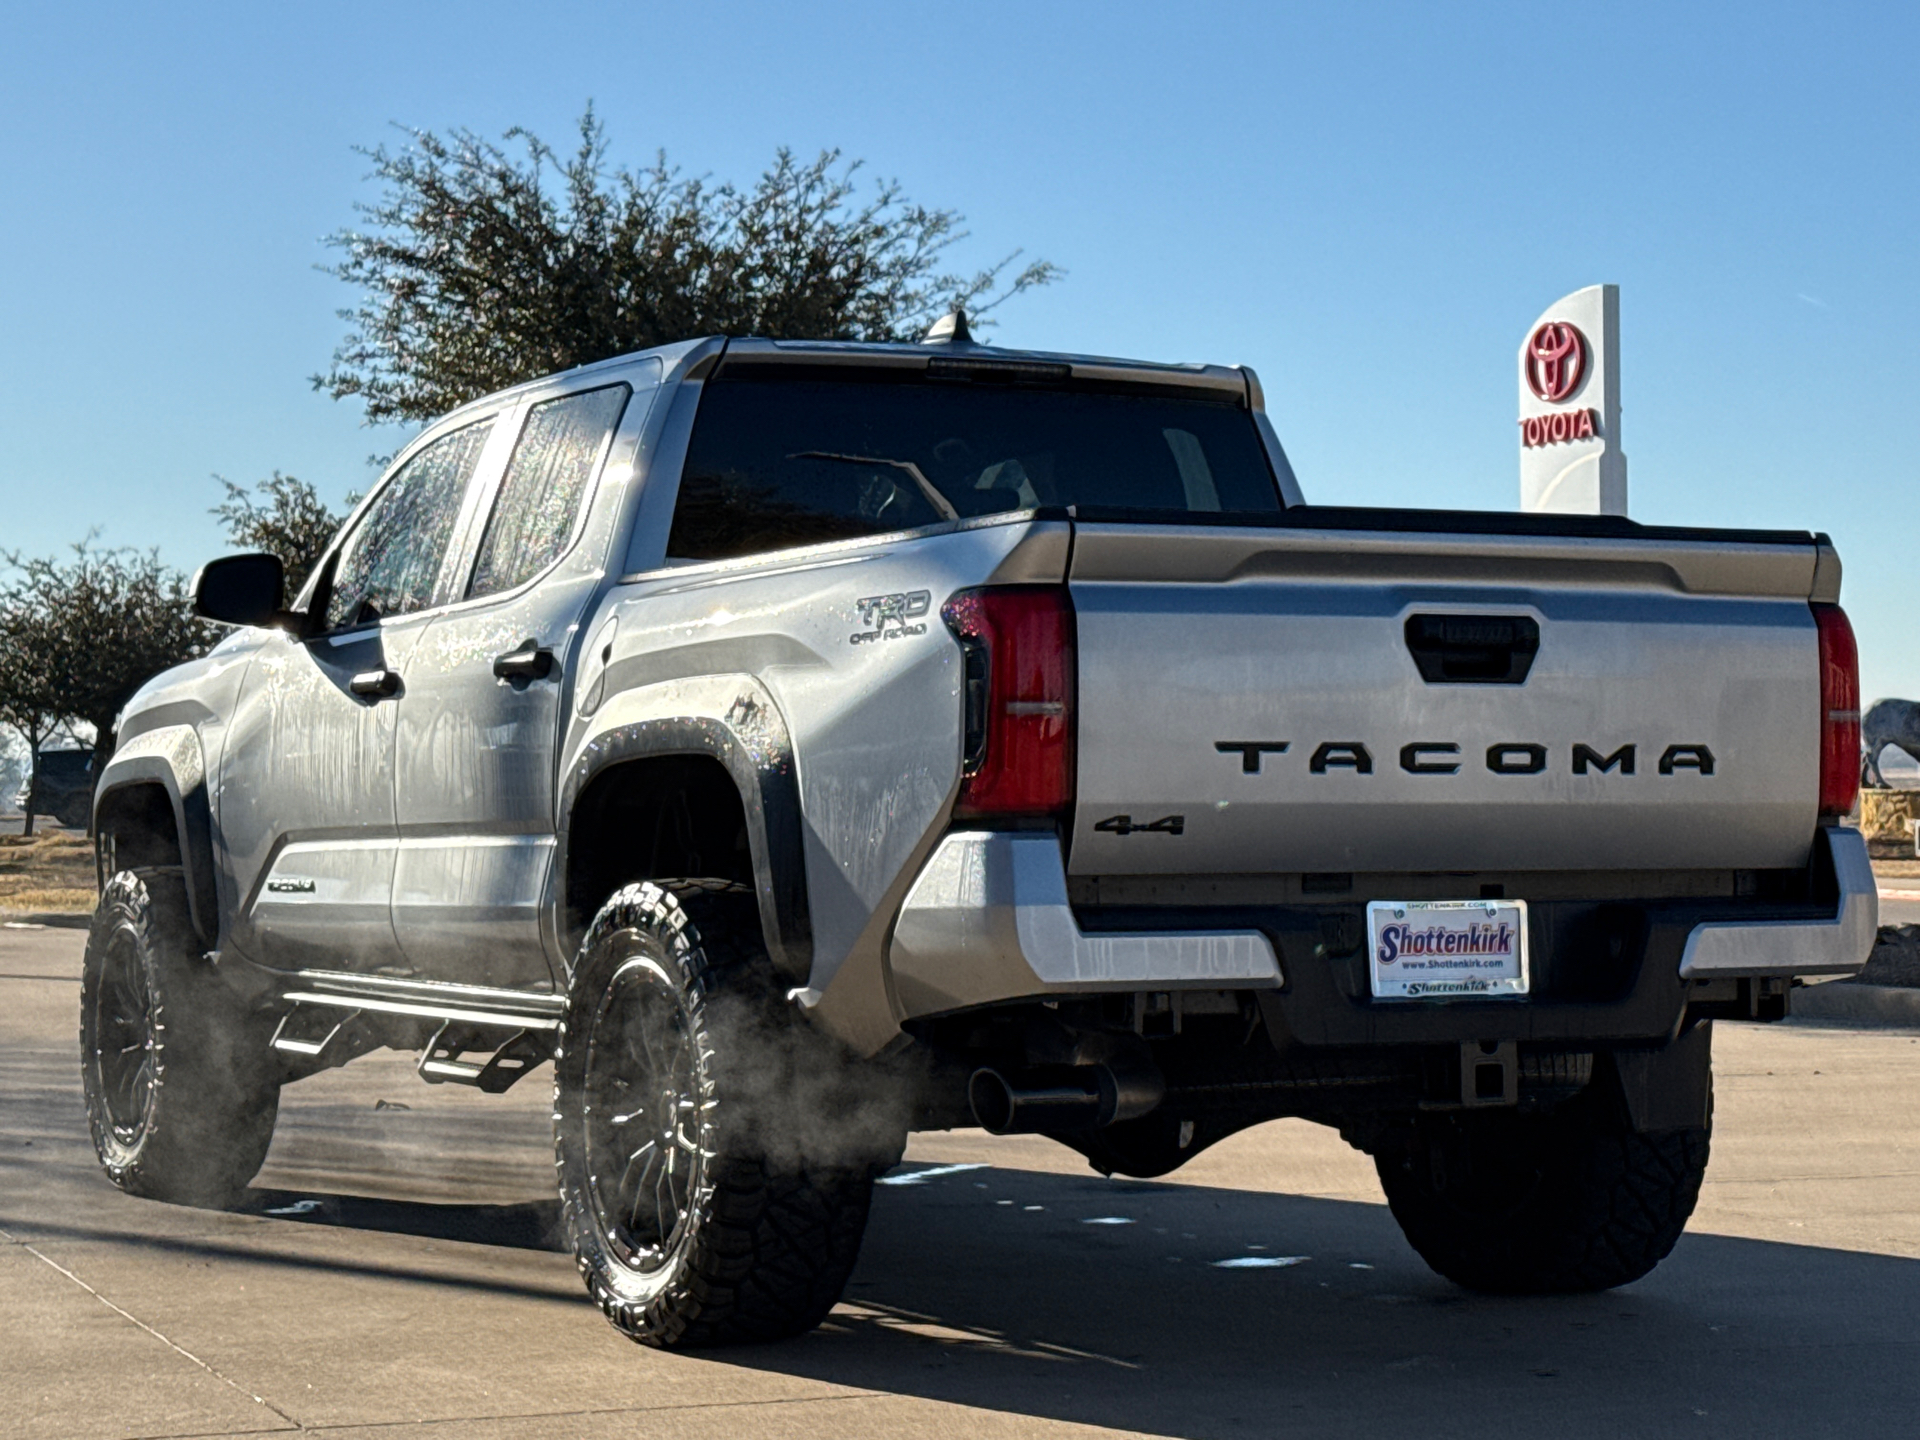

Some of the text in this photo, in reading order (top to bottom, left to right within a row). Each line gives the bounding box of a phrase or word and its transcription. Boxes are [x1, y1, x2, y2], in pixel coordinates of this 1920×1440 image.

[1518, 408, 1598, 449] TOYOTA
[856, 589, 931, 630] TRD
[1215, 741, 1715, 776] TACOMA
[1378, 923, 1515, 965] Shottenkirk
[1402, 959, 1504, 970] www.Shottenkirk.com
[1407, 977, 1490, 995] Shottenkirk
